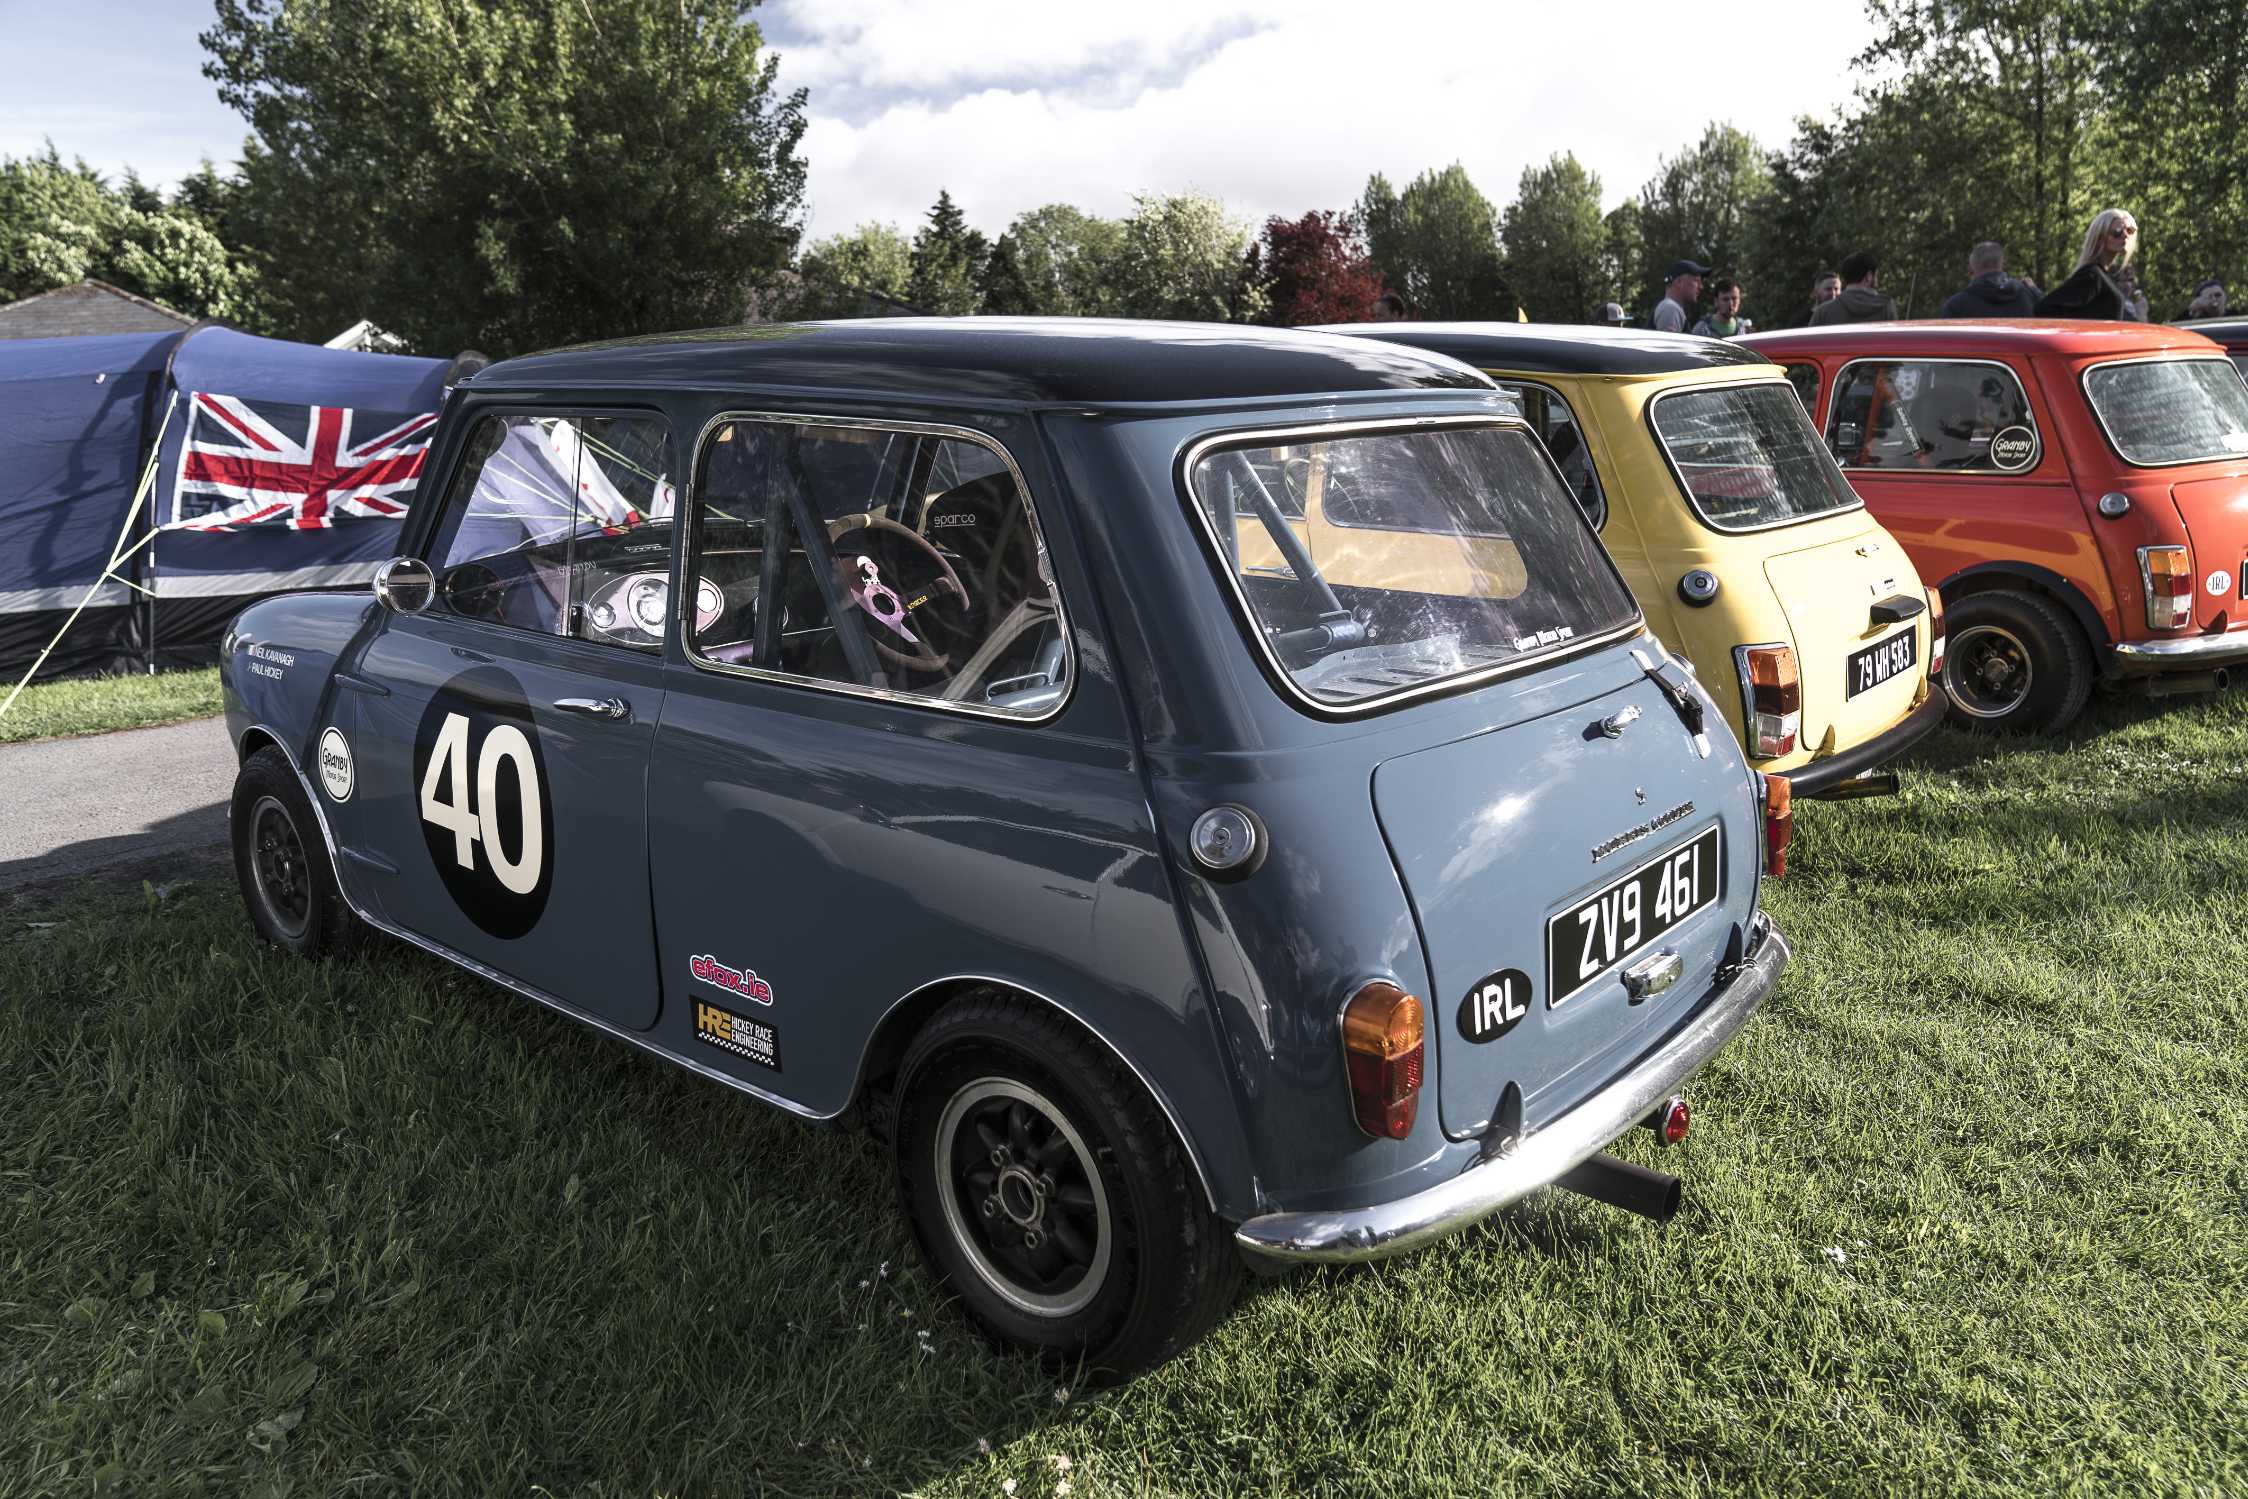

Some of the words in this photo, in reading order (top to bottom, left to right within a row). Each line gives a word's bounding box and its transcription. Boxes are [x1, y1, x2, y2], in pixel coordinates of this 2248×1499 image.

[1995, 438, 2031, 452] GRANBY
[934, 514, 976, 528] sparco
[2211, 576, 2225, 590] IRL
[251, 662, 264, 675] PAUL
[264, 665, 283, 680] HICKEY
[265, 649, 294, 667] KAVANAGH
[1858, 654, 1873, 691] 79
[1875, 645, 1890, 682] WH
[1891, 635, 1910, 674] 583
[322, 747, 348, 774] GRANBY
[420, 712, 542, 894] 40
[1578, 880, 1641, 981] ZV9
[1655, 843, 1699, 925] 461
[1473, 978, 1526, 1035] IRL
[731, 1015, 754, 1036] HICKEY
[755, 1024, 773, 1043] RACE
[731, 1029, 774, 1056] ENGINEERING
